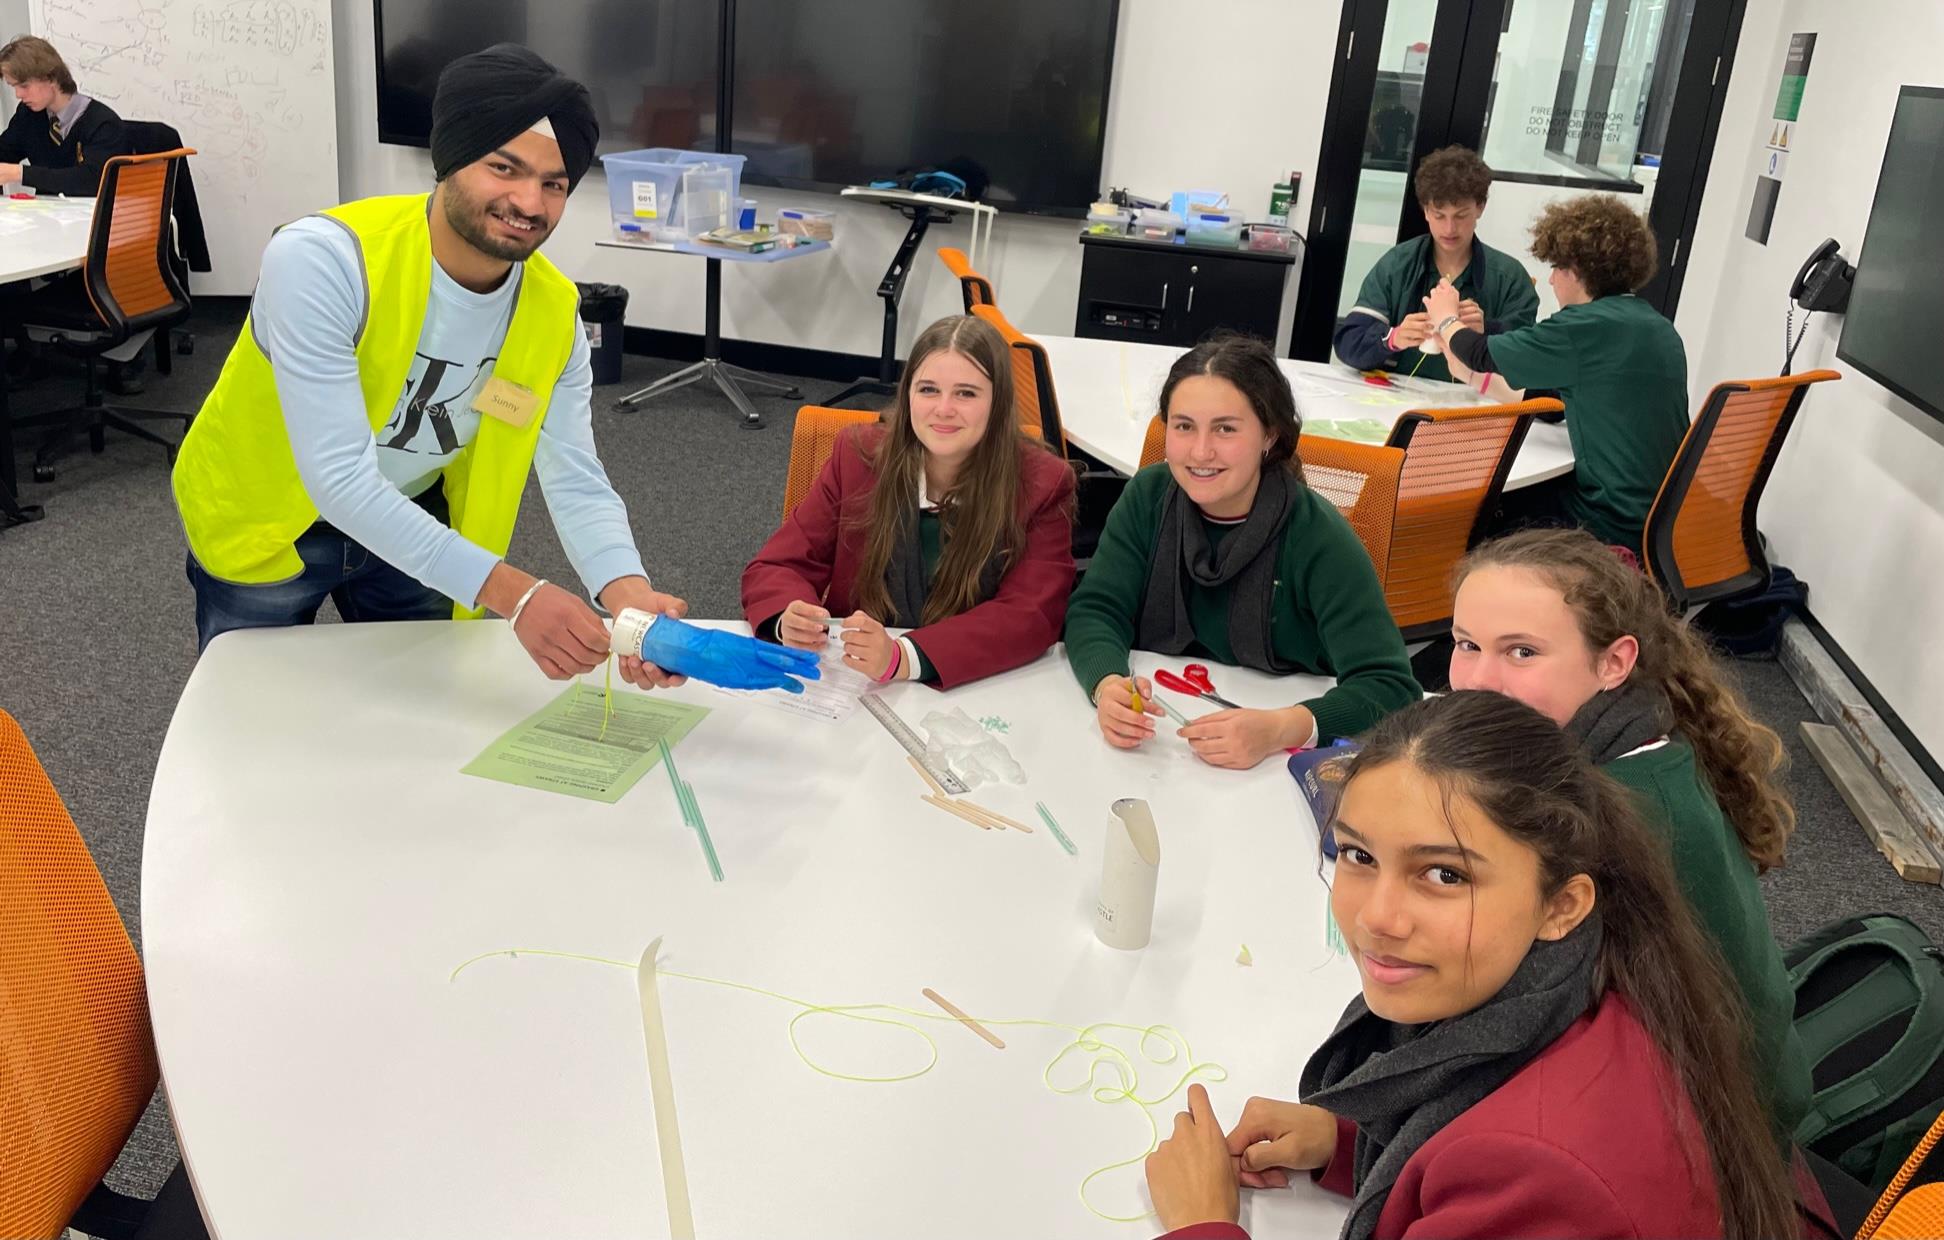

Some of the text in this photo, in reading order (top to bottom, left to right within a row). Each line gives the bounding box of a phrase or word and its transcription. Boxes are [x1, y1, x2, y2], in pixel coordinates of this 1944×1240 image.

[1531, 106, 1623, 121] FIRE SAFETY DOOR
[1529, 116, 1621, 131] DO NOT OBSTRUCT
[1526, 127, 1620, 142] DO NOT KEEP OPEN
[493, 394, 520, 413] Sunny
